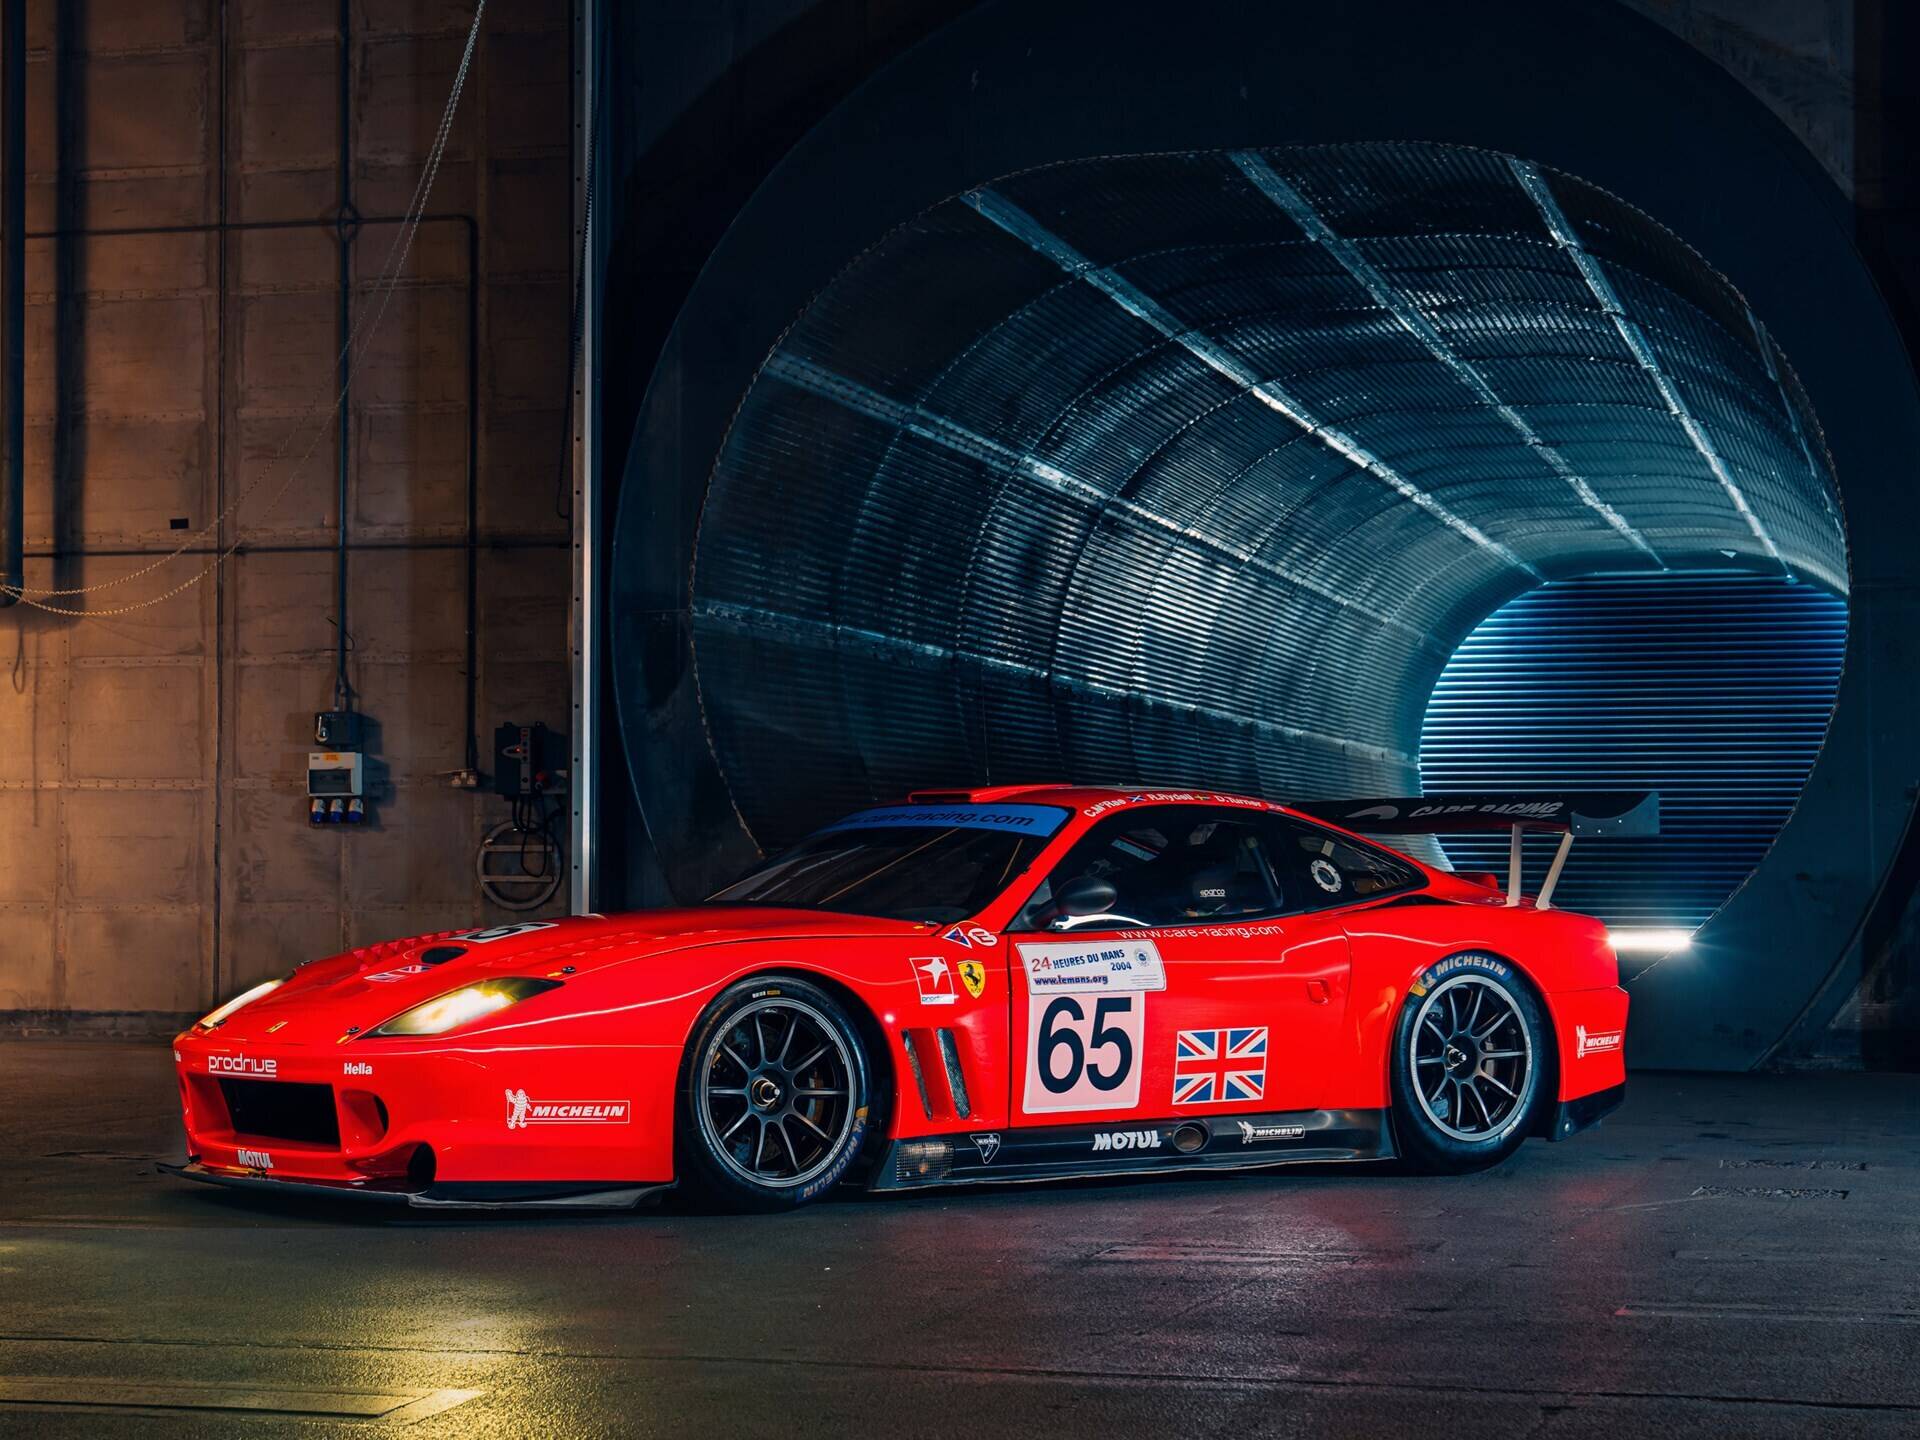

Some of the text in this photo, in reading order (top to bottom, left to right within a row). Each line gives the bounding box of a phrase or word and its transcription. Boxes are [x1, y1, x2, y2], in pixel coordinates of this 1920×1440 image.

[1478, 802, 1564, 815] RACING
[1116, 924, 1284, 939] www.care-racing.com
[1031, 949, 1125, 972] 24 HEURES DU MANS
[1110, 960, 1132, 971] 2004
[1434, 955, 1507, 977] MICHELIN
[1034, 974, 1108, 985] www.lemans.org
[1037, 996, 1133, 1094] 65
[1586, 1034, 1620, 1048] MICHELIN
[208, 1053, 277, 1073] prodrive
[343, 1063, 373, 1075] Hella
[531, 1105, 625, 1117] MICHELIN
[1255, 1125, 1303, 1138] MICHELIN
[1092, 1130, 1162, 1151] MOTUL
[237, 1149, 274, 1169] MOTUL
